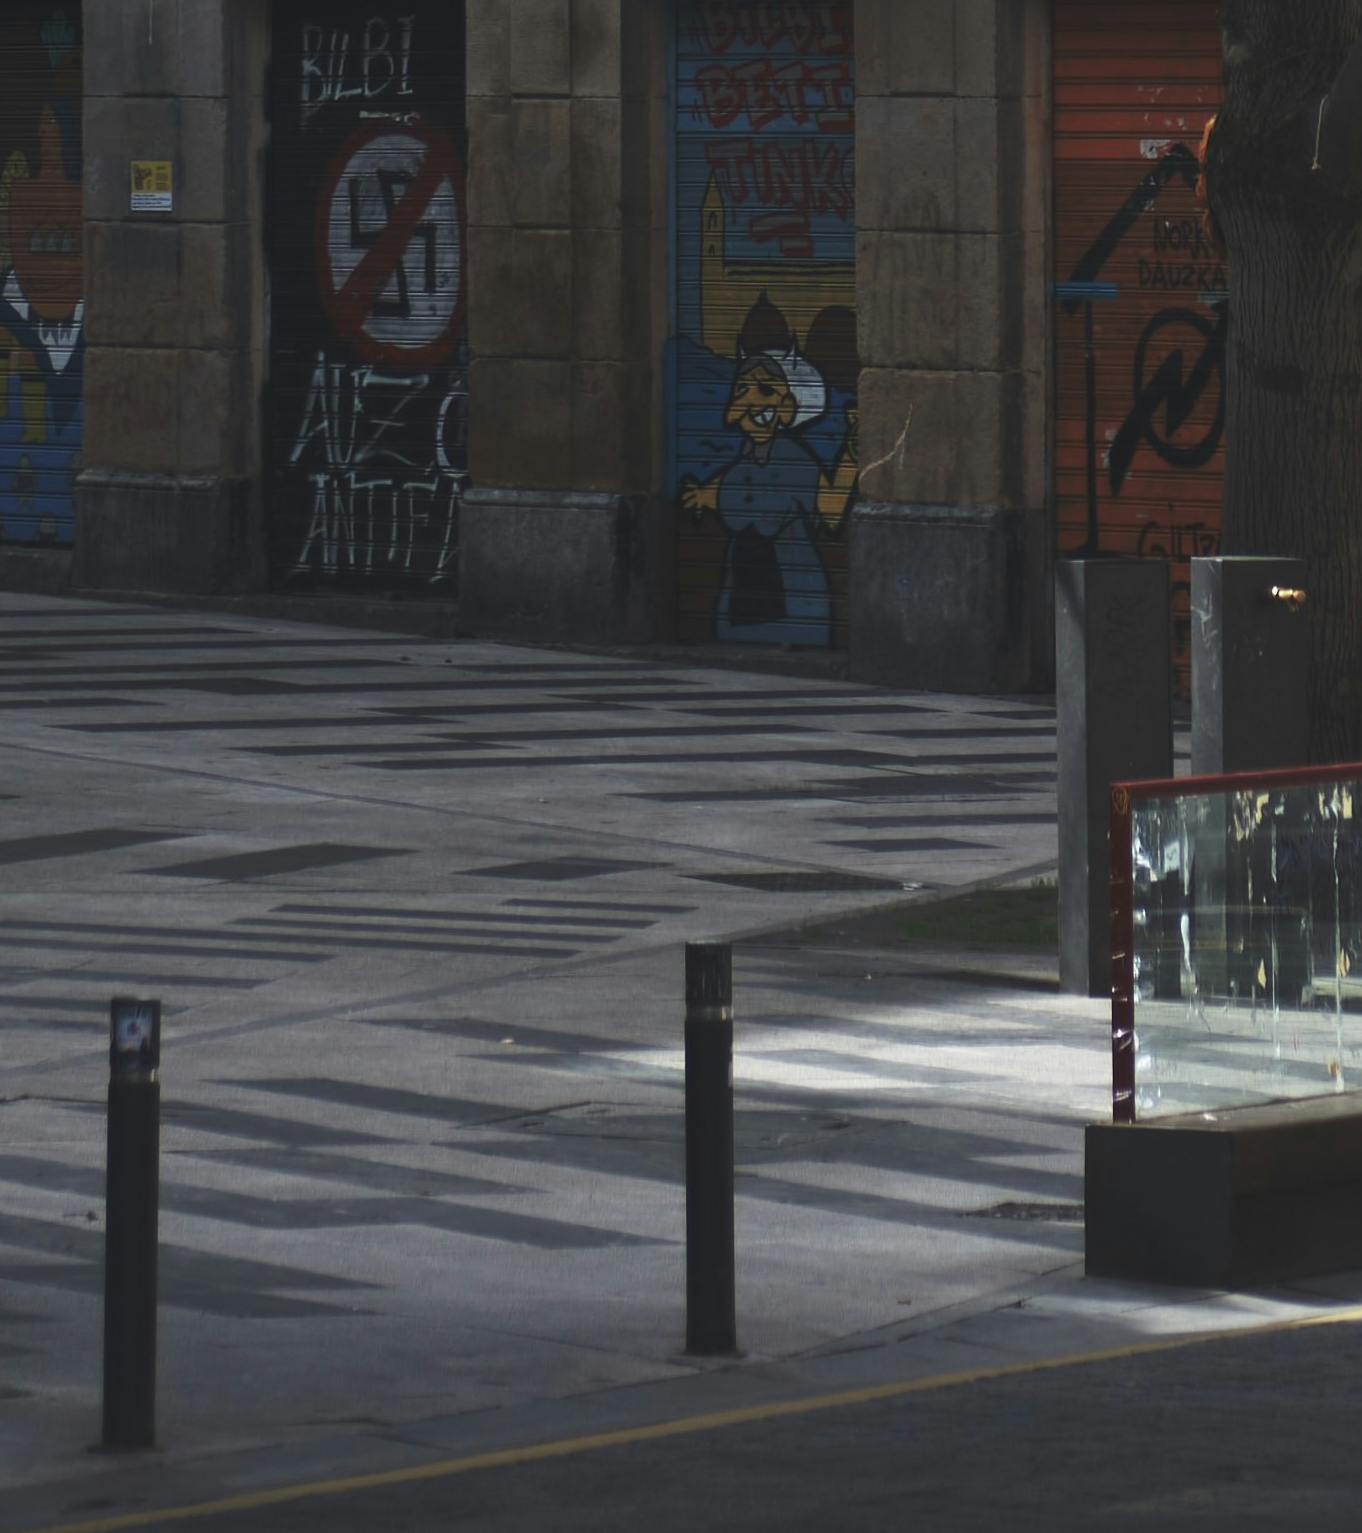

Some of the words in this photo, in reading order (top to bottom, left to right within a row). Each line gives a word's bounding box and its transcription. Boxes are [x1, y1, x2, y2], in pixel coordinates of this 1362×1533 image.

[301, 13, 416, 106] BILBI
[696, 57, 854, 132] BETI
[703, 136, 855, 219] TINK
